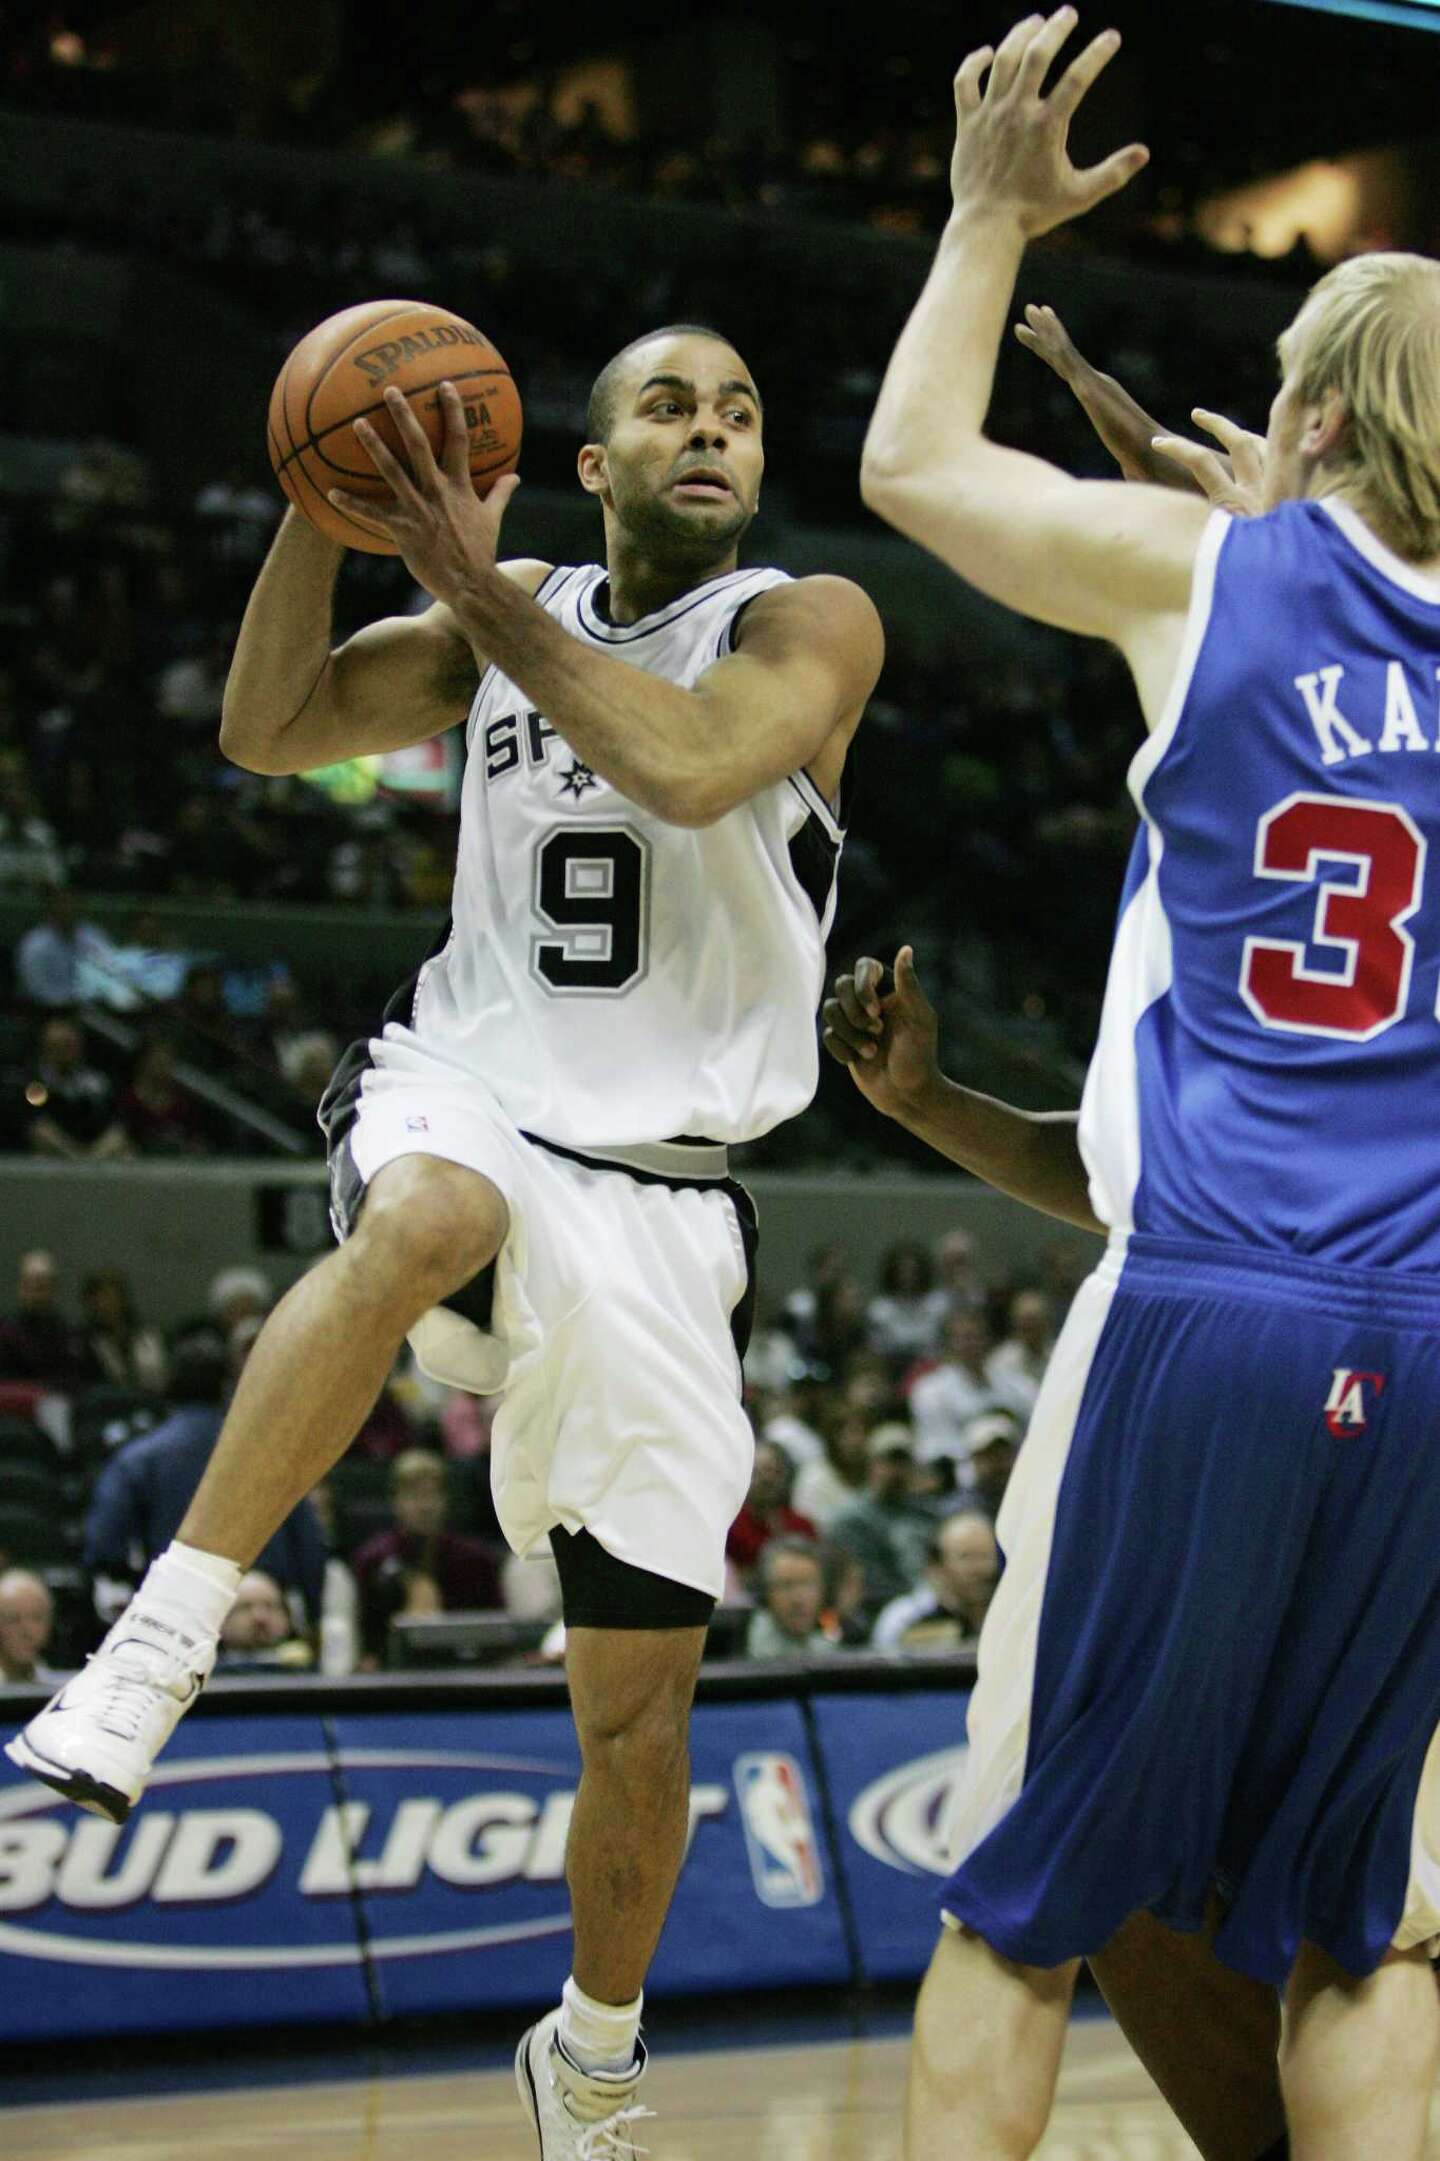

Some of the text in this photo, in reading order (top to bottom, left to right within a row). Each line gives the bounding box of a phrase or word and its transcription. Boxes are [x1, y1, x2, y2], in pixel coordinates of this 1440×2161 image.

[354, 325, 486, 389] SPALDIN
[463, 401, 492, 429] BA
[485, 711, 557, 779] SP
[1294, 661, 1440, 766] KA
[530, 822, 652, 999] 9
[1238, 791, 1440, 1042] 3
[0, 1806, 283, 1912] BUD
